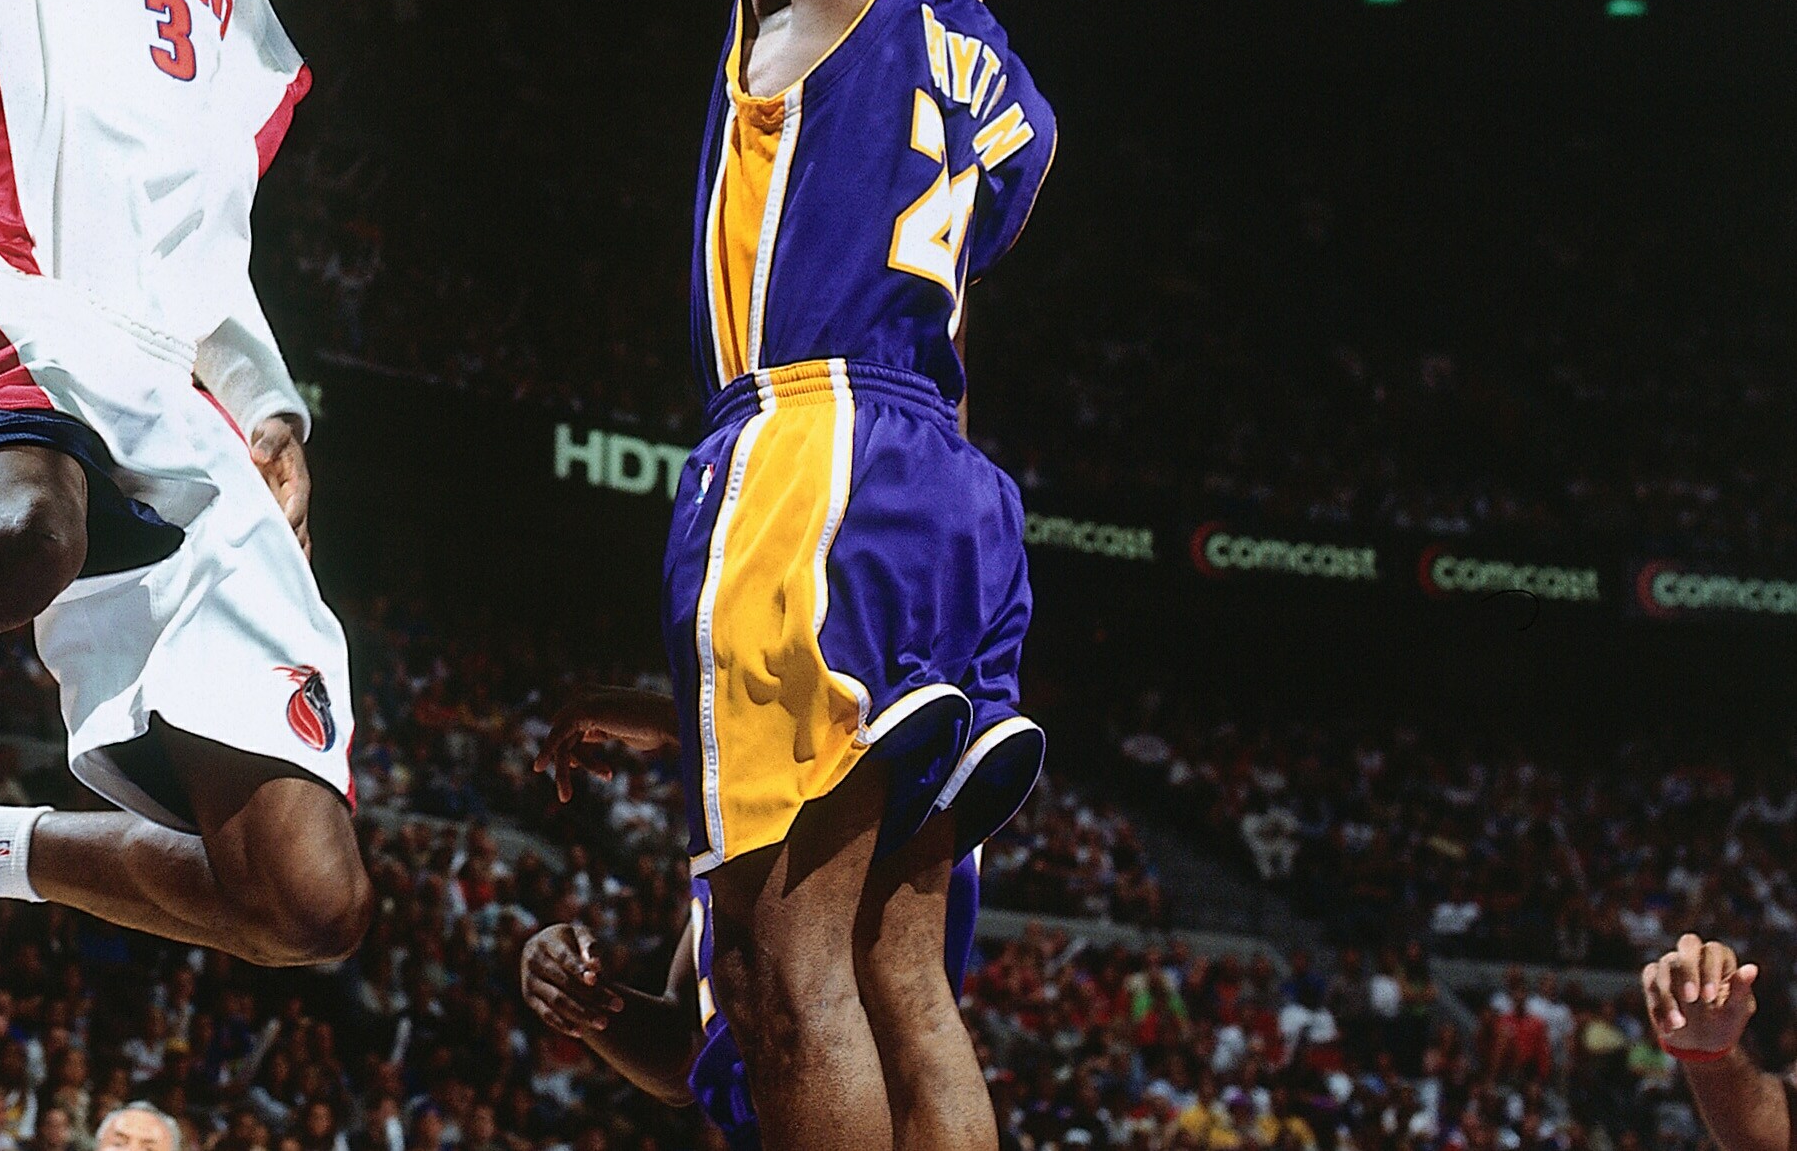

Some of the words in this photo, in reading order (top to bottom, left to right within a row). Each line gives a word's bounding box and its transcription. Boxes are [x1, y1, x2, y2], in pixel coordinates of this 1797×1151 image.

[554, 422, 692, 501] HDT
[1024, 511, 1154, 560] omcast
[1205, 531, 1376, 580] comcast
[1431, 554, 1599, 601] comcast
[1652, 570, 1797, 615] comca
